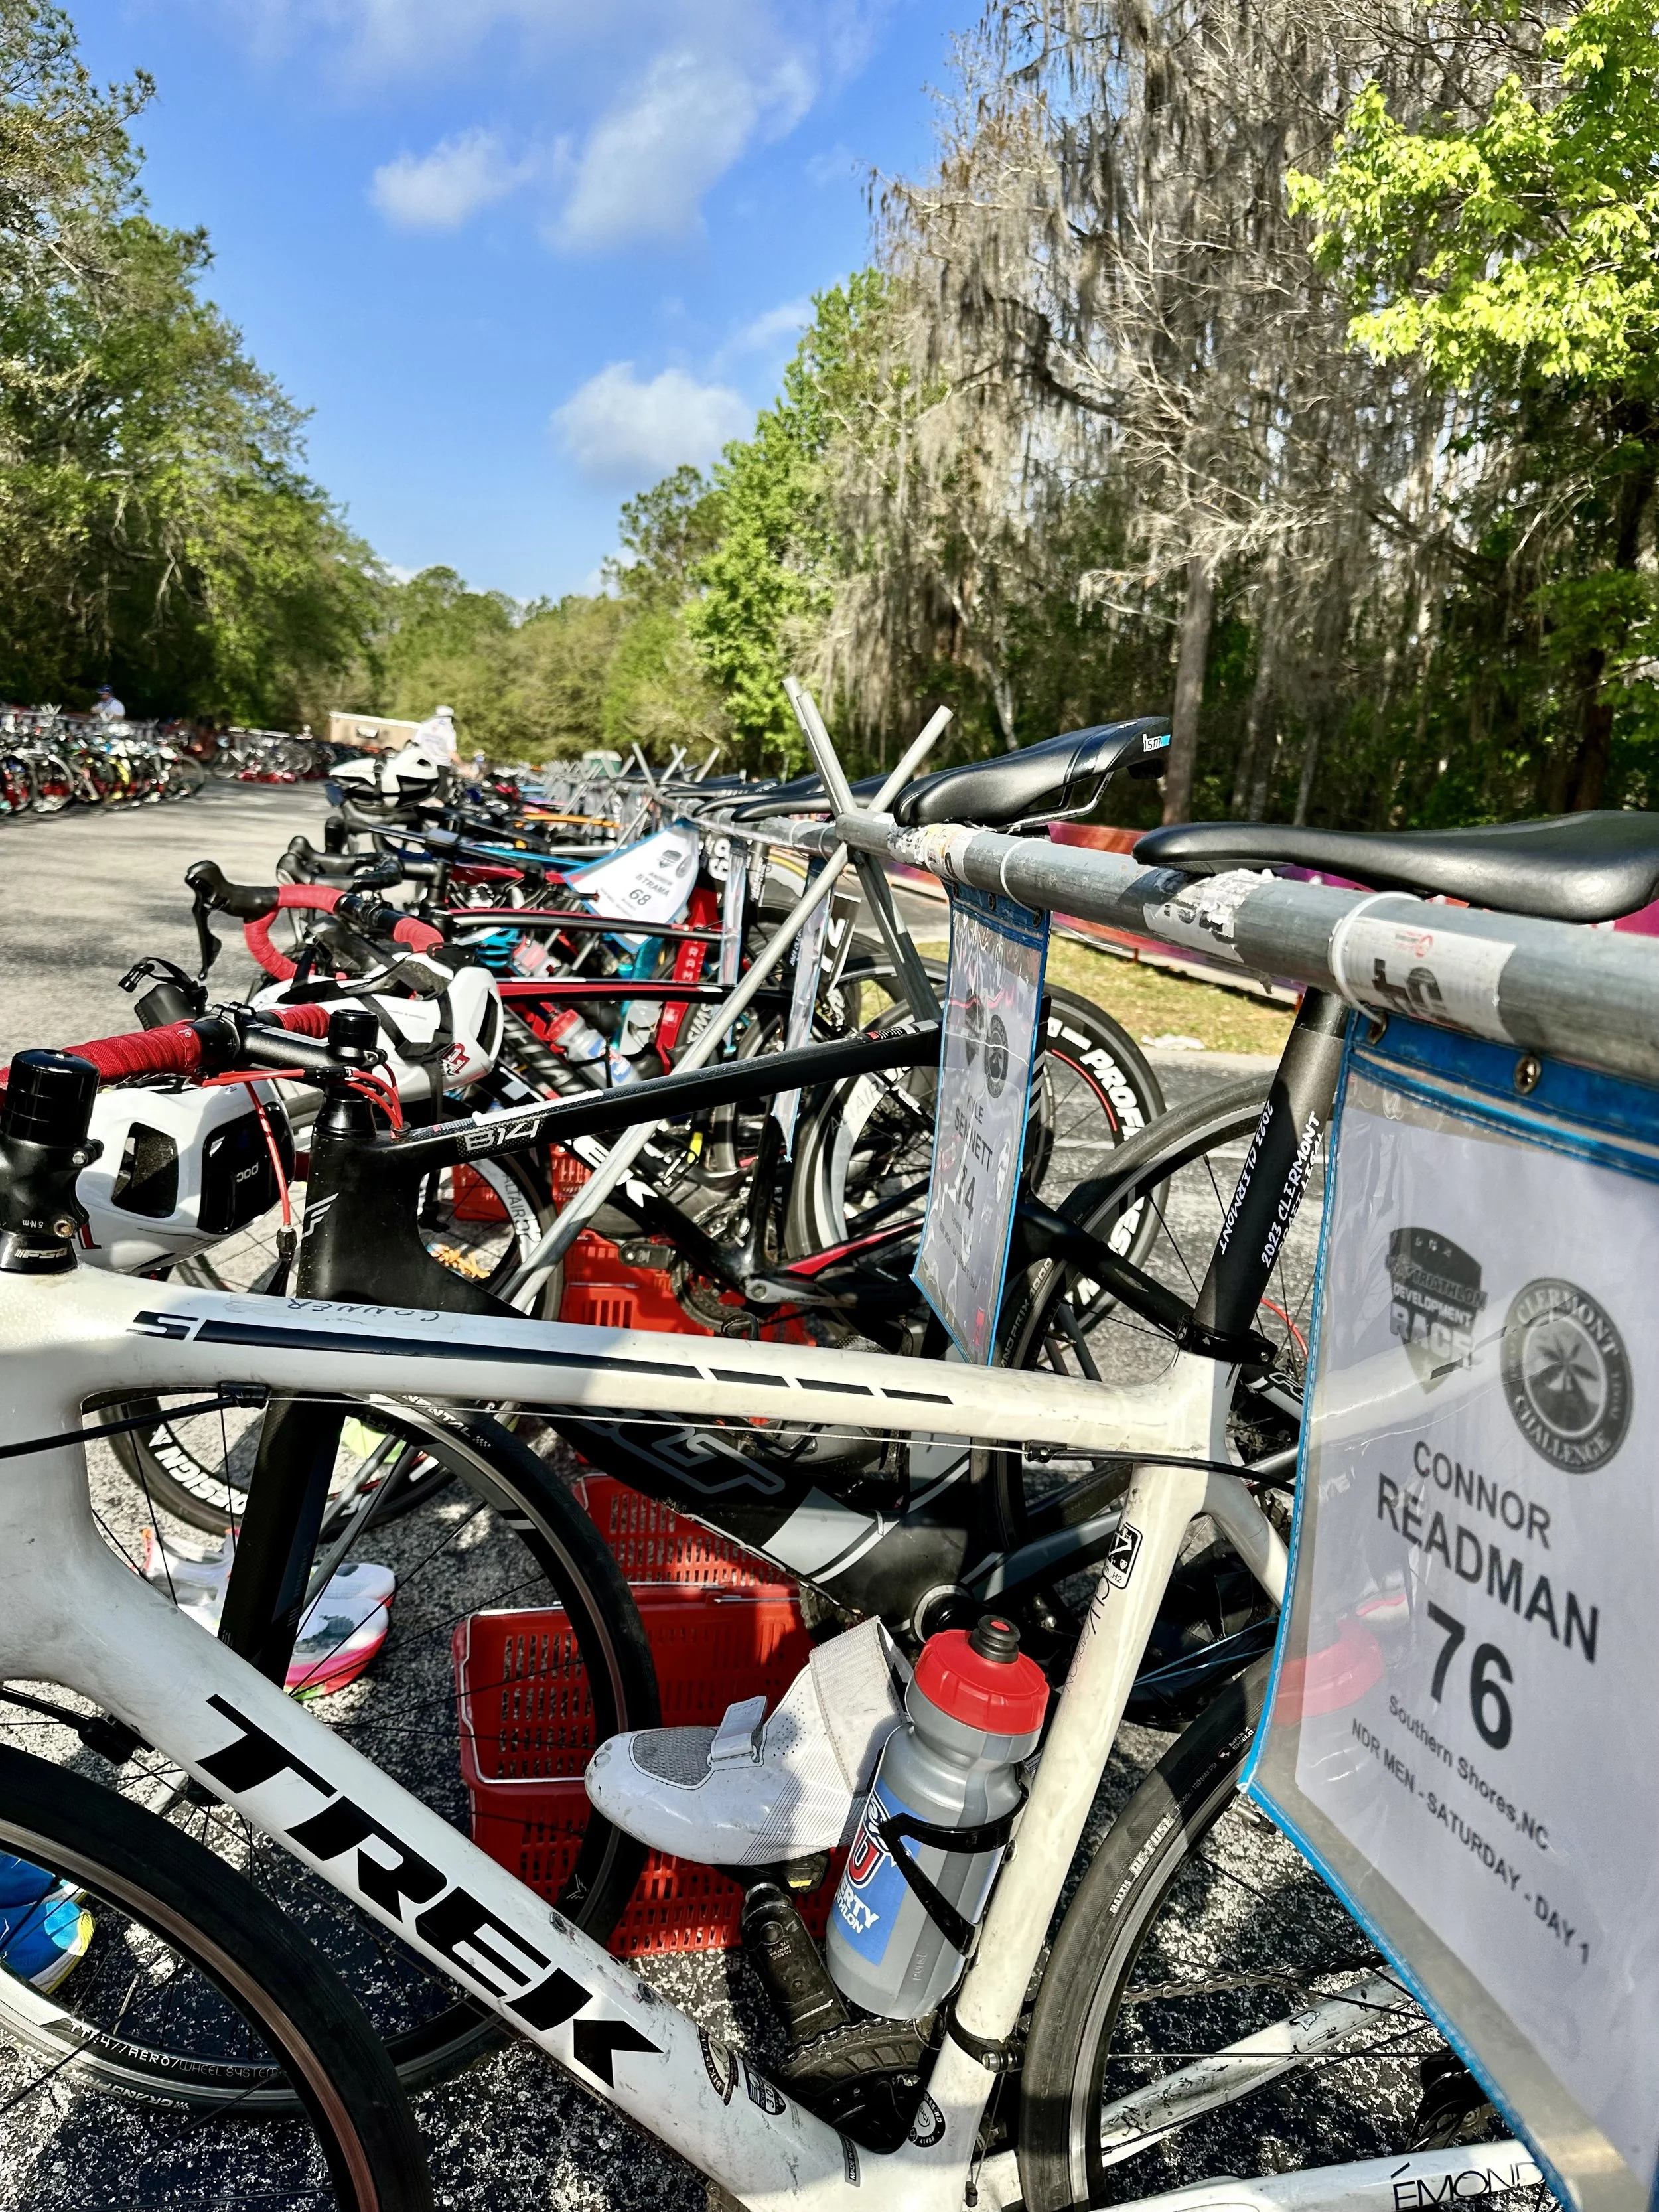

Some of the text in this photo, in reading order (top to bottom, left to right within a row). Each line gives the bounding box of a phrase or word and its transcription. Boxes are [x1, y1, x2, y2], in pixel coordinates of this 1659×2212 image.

[629, 889, 652, 905] 68
[636, 874, 670, 897] STRAMA
[1079, 1048, 1145, 1141] PROF
[1220, 1100, 1273, 1255] 2023 CLERMONT
[1262, 1110, 1320, 1268] 2023 CLERMONT
[1393, 1282, 1472, 1327] DEVELOPMENT
[1409, 1268, 1488, 1311] TRIATHLON
[1013, 1299, 1030, 1337] PRIX
[1390, 1299, 1473, 1370] RACE
[1517, 1288, 1619, 1355] CLERMONT
[1413, 1441, 1551, 1550] CONNOR
[1112, 1572, 1122, 1583] H2
[1377, 1473, 1599, 1664] READMAN
[1427, 1600, 1514, 1751] 76
[1228, 1726, 1250, 1747] MAXX
[1232, 1730, 1254, 1750] SHIELD
[1390, 1695, 1550, 1851] Southern Shores,NC
[1384, 1748, 1415, 1793] MEN
[1427, 1792, 1521, 1892] SATURDAY
[1534, 1899, 1575, 1948] DAY
[1580, 1942, 1590, 1965] 1
[195, 1694, 664, 2089] TREK
[835, 1893, 864, 1934] THLON
[838, 1874, 880, 1929] ERTY
[1109, 1878, 1132, 1916] MAXXIS
[114, 2085, 177, 2108] GRAND
[705, 2055, 722, 2090] BIKES
[1391, 2162, 1544, 2211] ÉMOND
